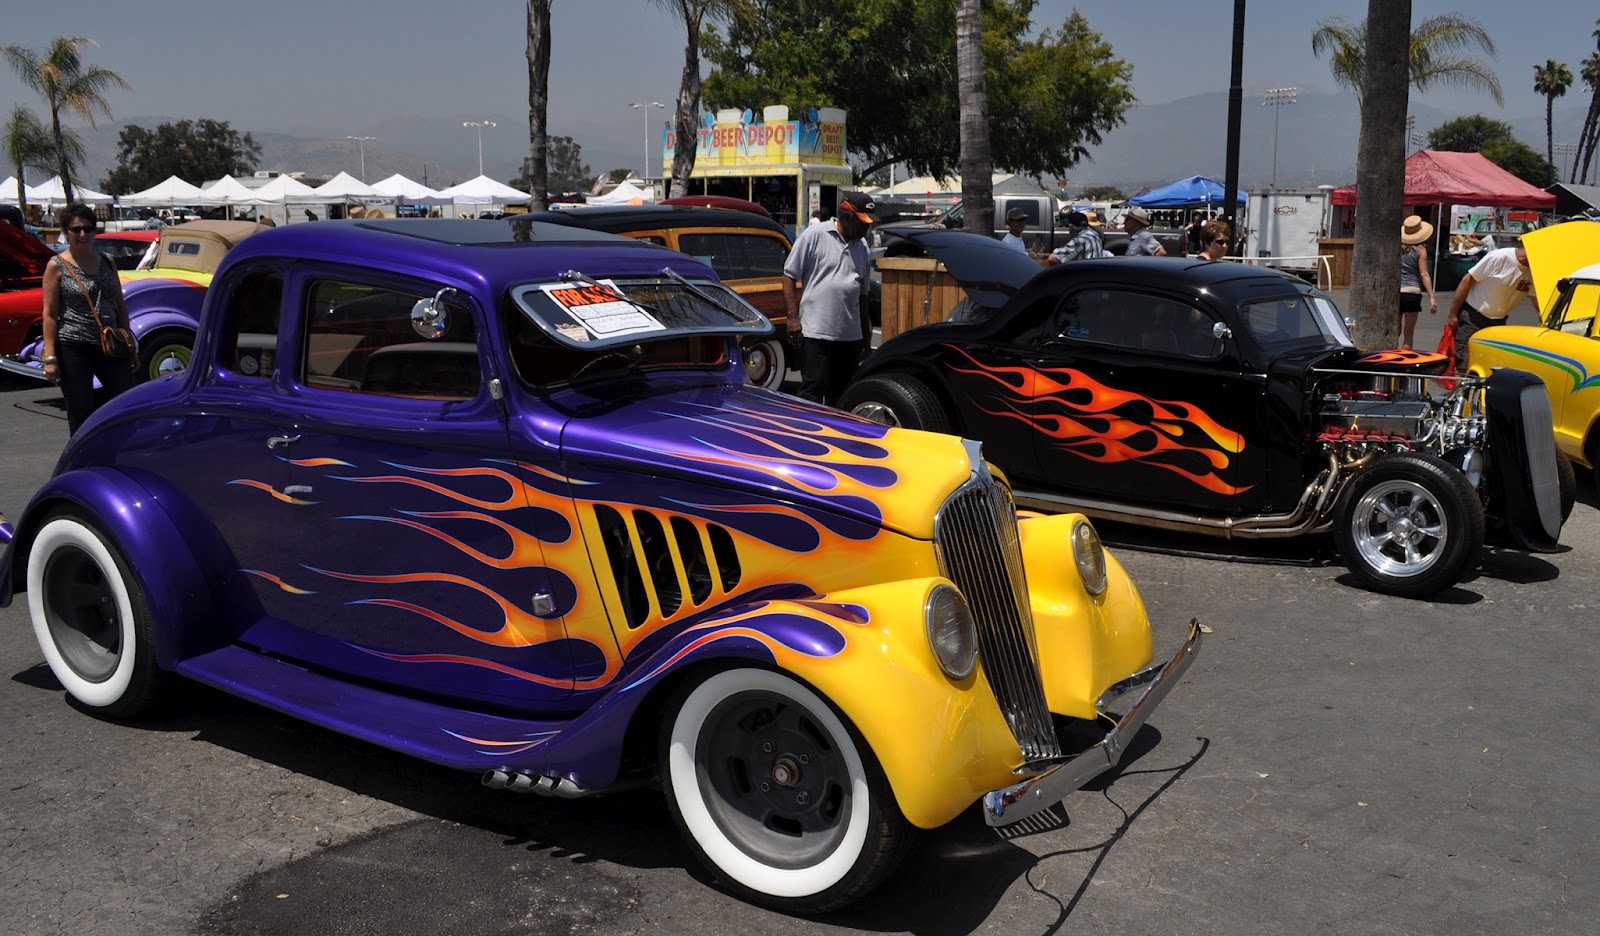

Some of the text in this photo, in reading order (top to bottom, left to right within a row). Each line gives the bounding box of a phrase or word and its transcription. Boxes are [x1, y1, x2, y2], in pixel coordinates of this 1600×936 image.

[822, 124, 844, 134] DRAFT
[666, 124, 797, 151] DFT BEER DEPOT
[826, 134, 841, 144] BEER
[822, 144, 844, 154] DEPOT
[551, 288, 591, 308] FOR
